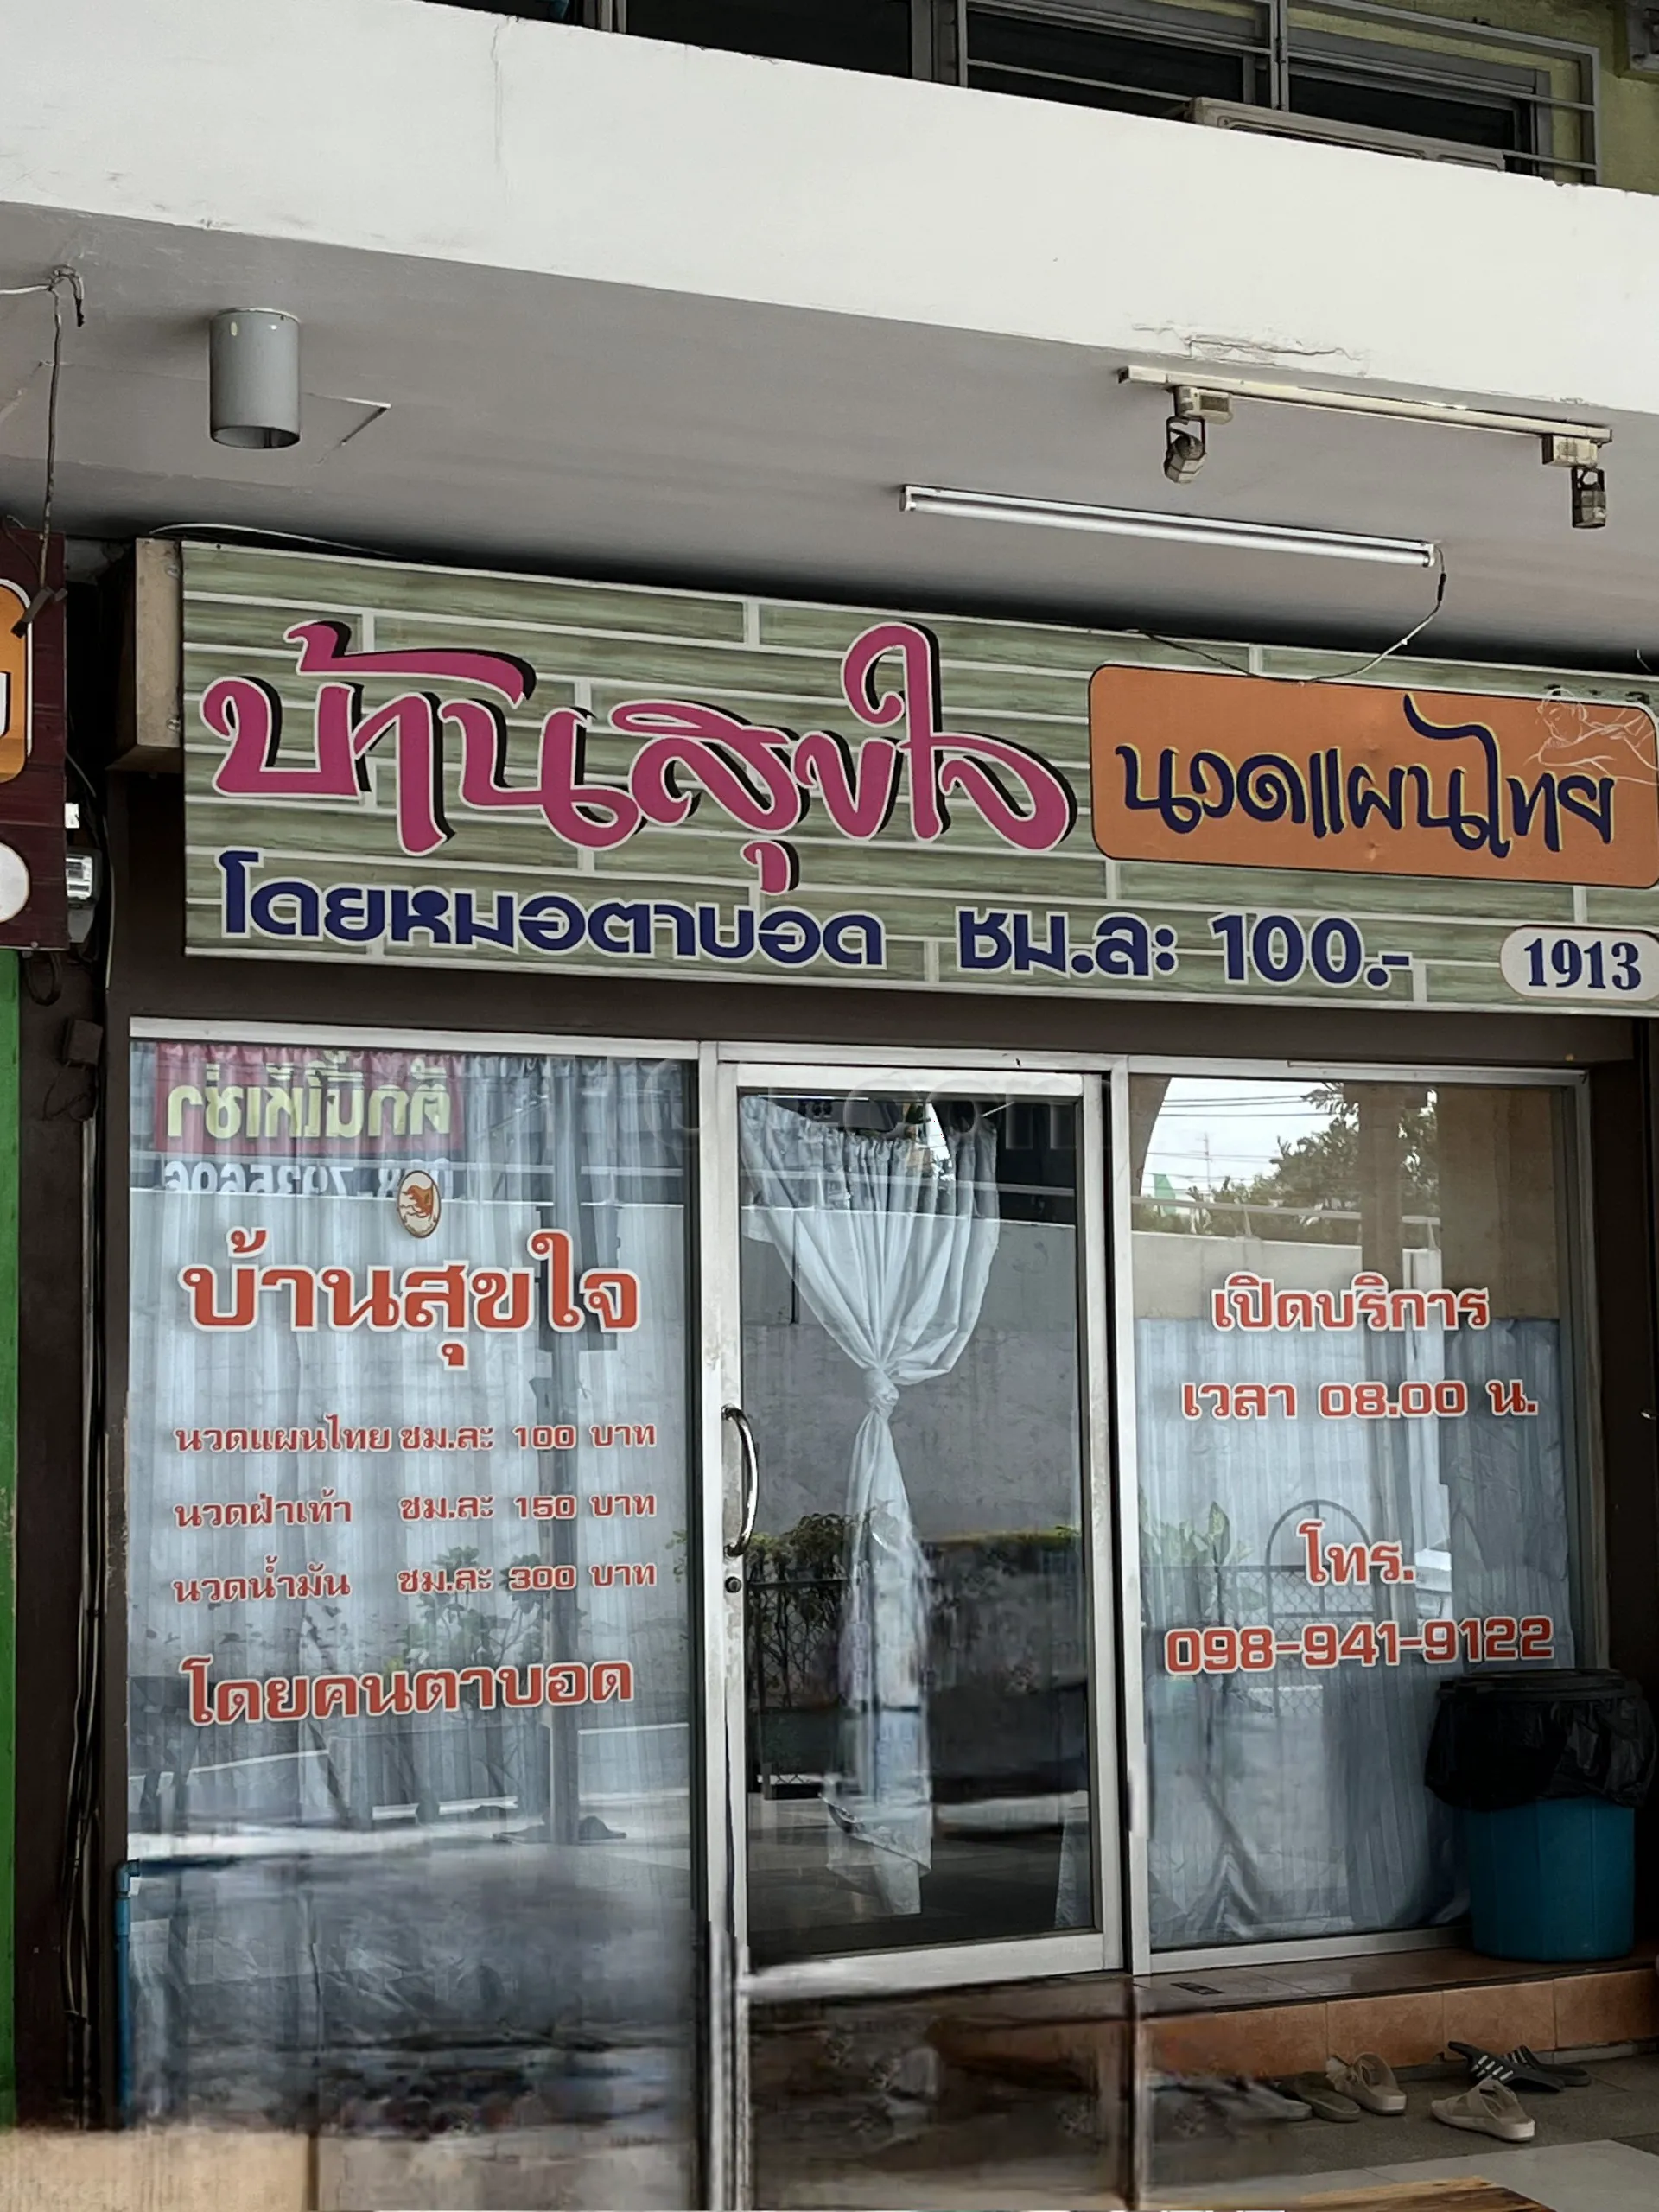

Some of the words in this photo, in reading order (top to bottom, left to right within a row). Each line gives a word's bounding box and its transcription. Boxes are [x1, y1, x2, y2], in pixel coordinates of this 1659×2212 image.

[201, 622, 1077, 895] บ้านสุขใจ
[1116, 693, 1614, 859] นวดแผนไทย
[218, 847, 888, 969] โดยหมอตาบอด
[1208, 912, 1414, 988] 100.-
[1522, 937, 1642, 992] 1913
[178, 1226, 641, 1371] บ้านสุขใจ
[1211, 1271, 1491, 1332] เปิดบริการ
[1181, 1382, 1296, 1420] เวลา
[1318, 1382, 1467, 1418] 08.00
[1485, 1379, 1539, 1417] น.
[174, 1414, 391, 1452] นวดแผนไทย
[513, 1426, 577, 1448] 100
[589, 1422, 657, 1447] บาท
[174, 1488, 353, 1528] นวดฝ่าเท้า
[513, 1496, 577, 1519] 150
[589, 1493, 657, 1518] บาท
[173, 1555, 352, 1605] นวดน้ำมัน
[507, 1565, 577, 1591] 300
[589, 1562, 657, 1588] บาท
[1297, 1518, 1415, 1586] โทร.
[1164, 1616, 1554, 1675] 098-941-9122
[179, 1655, 634, 1726] โดยคนตาบอด
